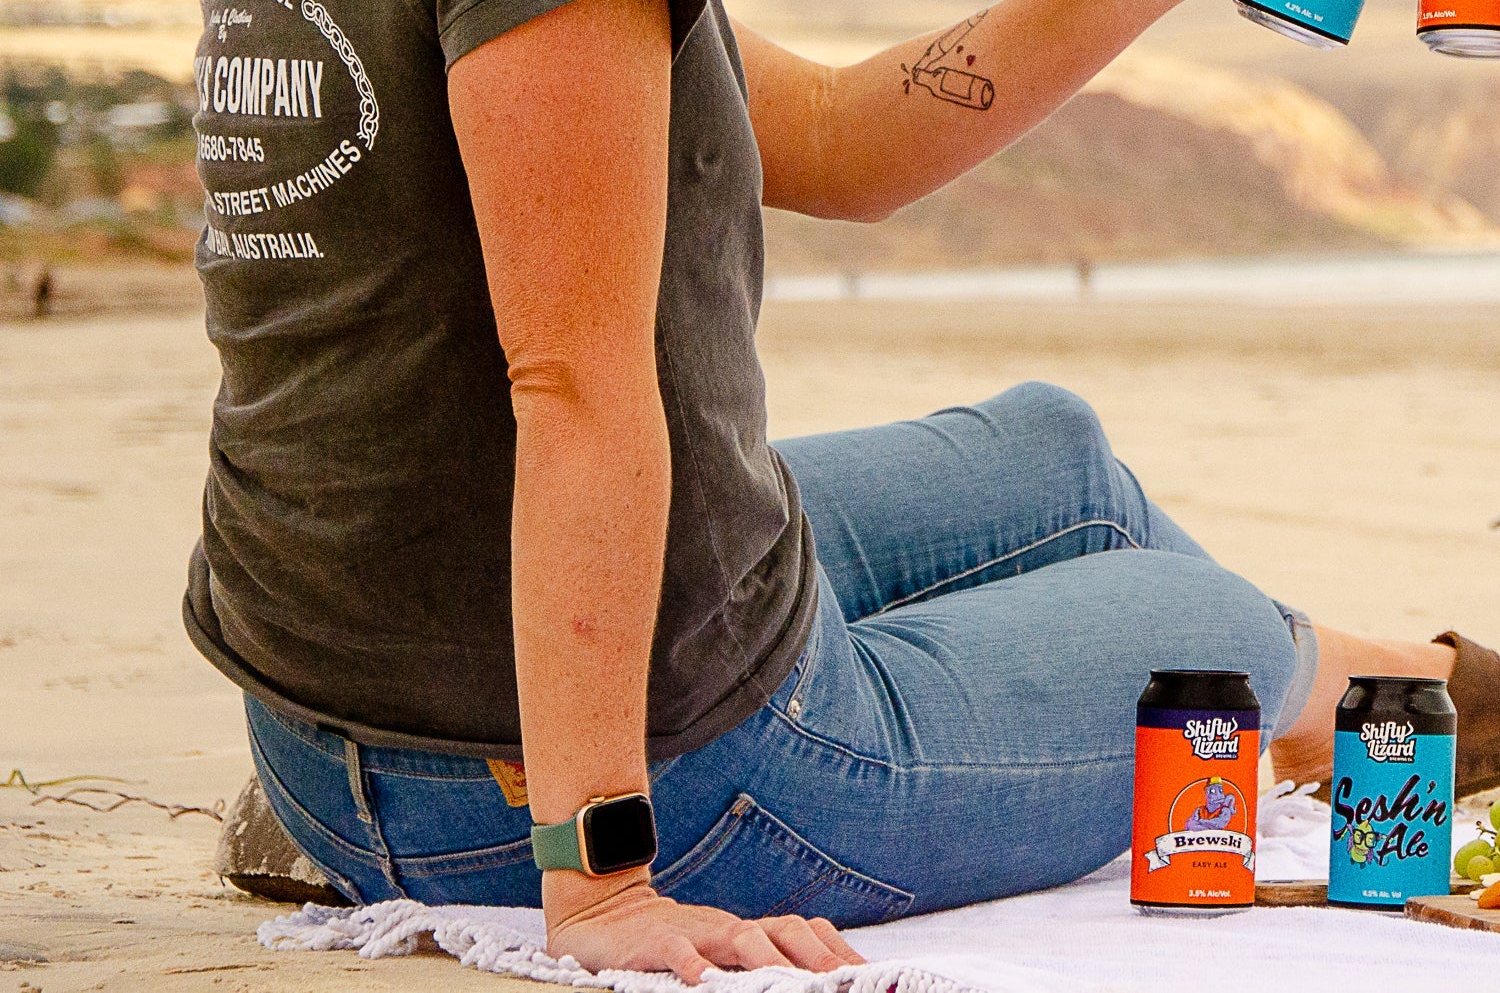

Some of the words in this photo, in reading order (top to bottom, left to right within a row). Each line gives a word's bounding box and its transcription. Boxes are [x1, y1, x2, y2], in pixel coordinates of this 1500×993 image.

[213, 55, 324, 118] COMPANY
[213, 187, 271, 216] STREET
[271, 139, 362, 208] MACHINES
[231, 232, 325, 260] AUSTRALIA.
[1184, 716, 1239, 741] Shifty
[1360, 720, 1415, 744] Shifty
[1192, 736, 1239, 759] Lizard
[1367, 739, 1416, 762] Lizard
[1332, 774, 1448, 841] Sesh'n
[1173, 835, 1242, 849] Brewski
[1375, 822, 1430, 867] Ale
